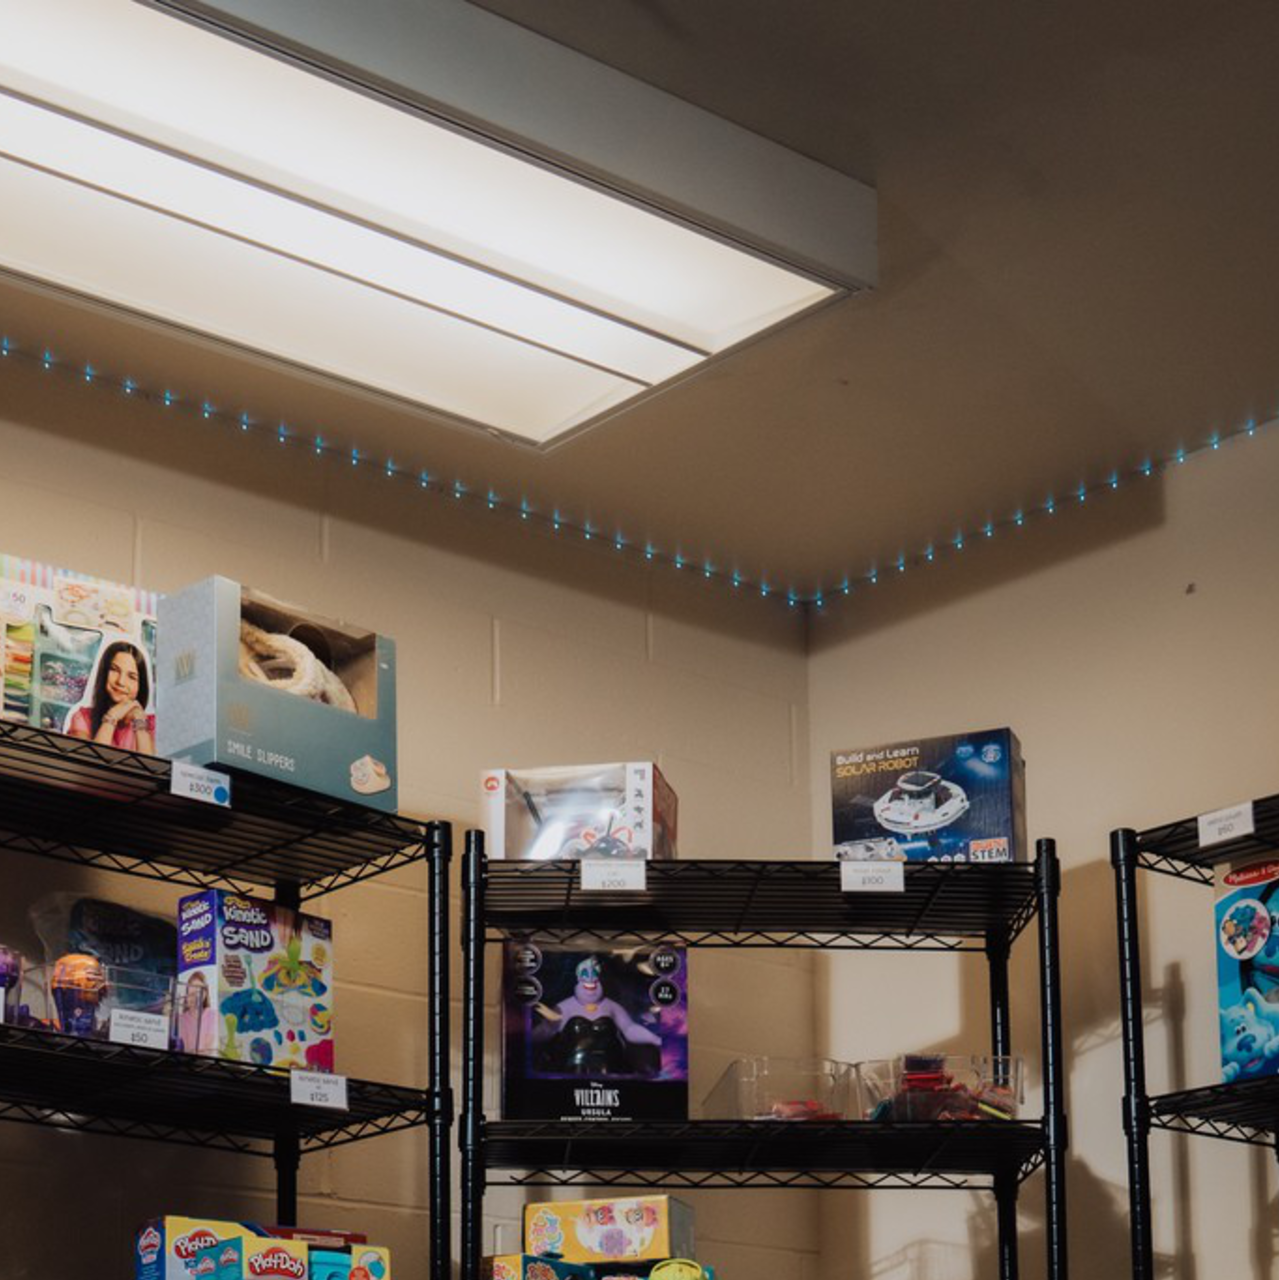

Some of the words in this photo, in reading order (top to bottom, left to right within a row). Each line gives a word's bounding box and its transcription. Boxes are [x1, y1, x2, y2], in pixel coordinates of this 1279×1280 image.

[227, 740, 252, 760] SMILE
[257, 749, 296, 772] SLIPPERS
[865, 752, 885, 763] and
[886, 746, 920, 761] Learn
[835, 762, 877, 779] SOLAR
[877, 756, 919, 773] ROBOT
[970, 847, 1009, 862] STEM
[222, 926, 272, 949] SAND
[574, 1089, 621, 1108] VILLAINS
[249, 1256, 303, 1280] Play-Doh
